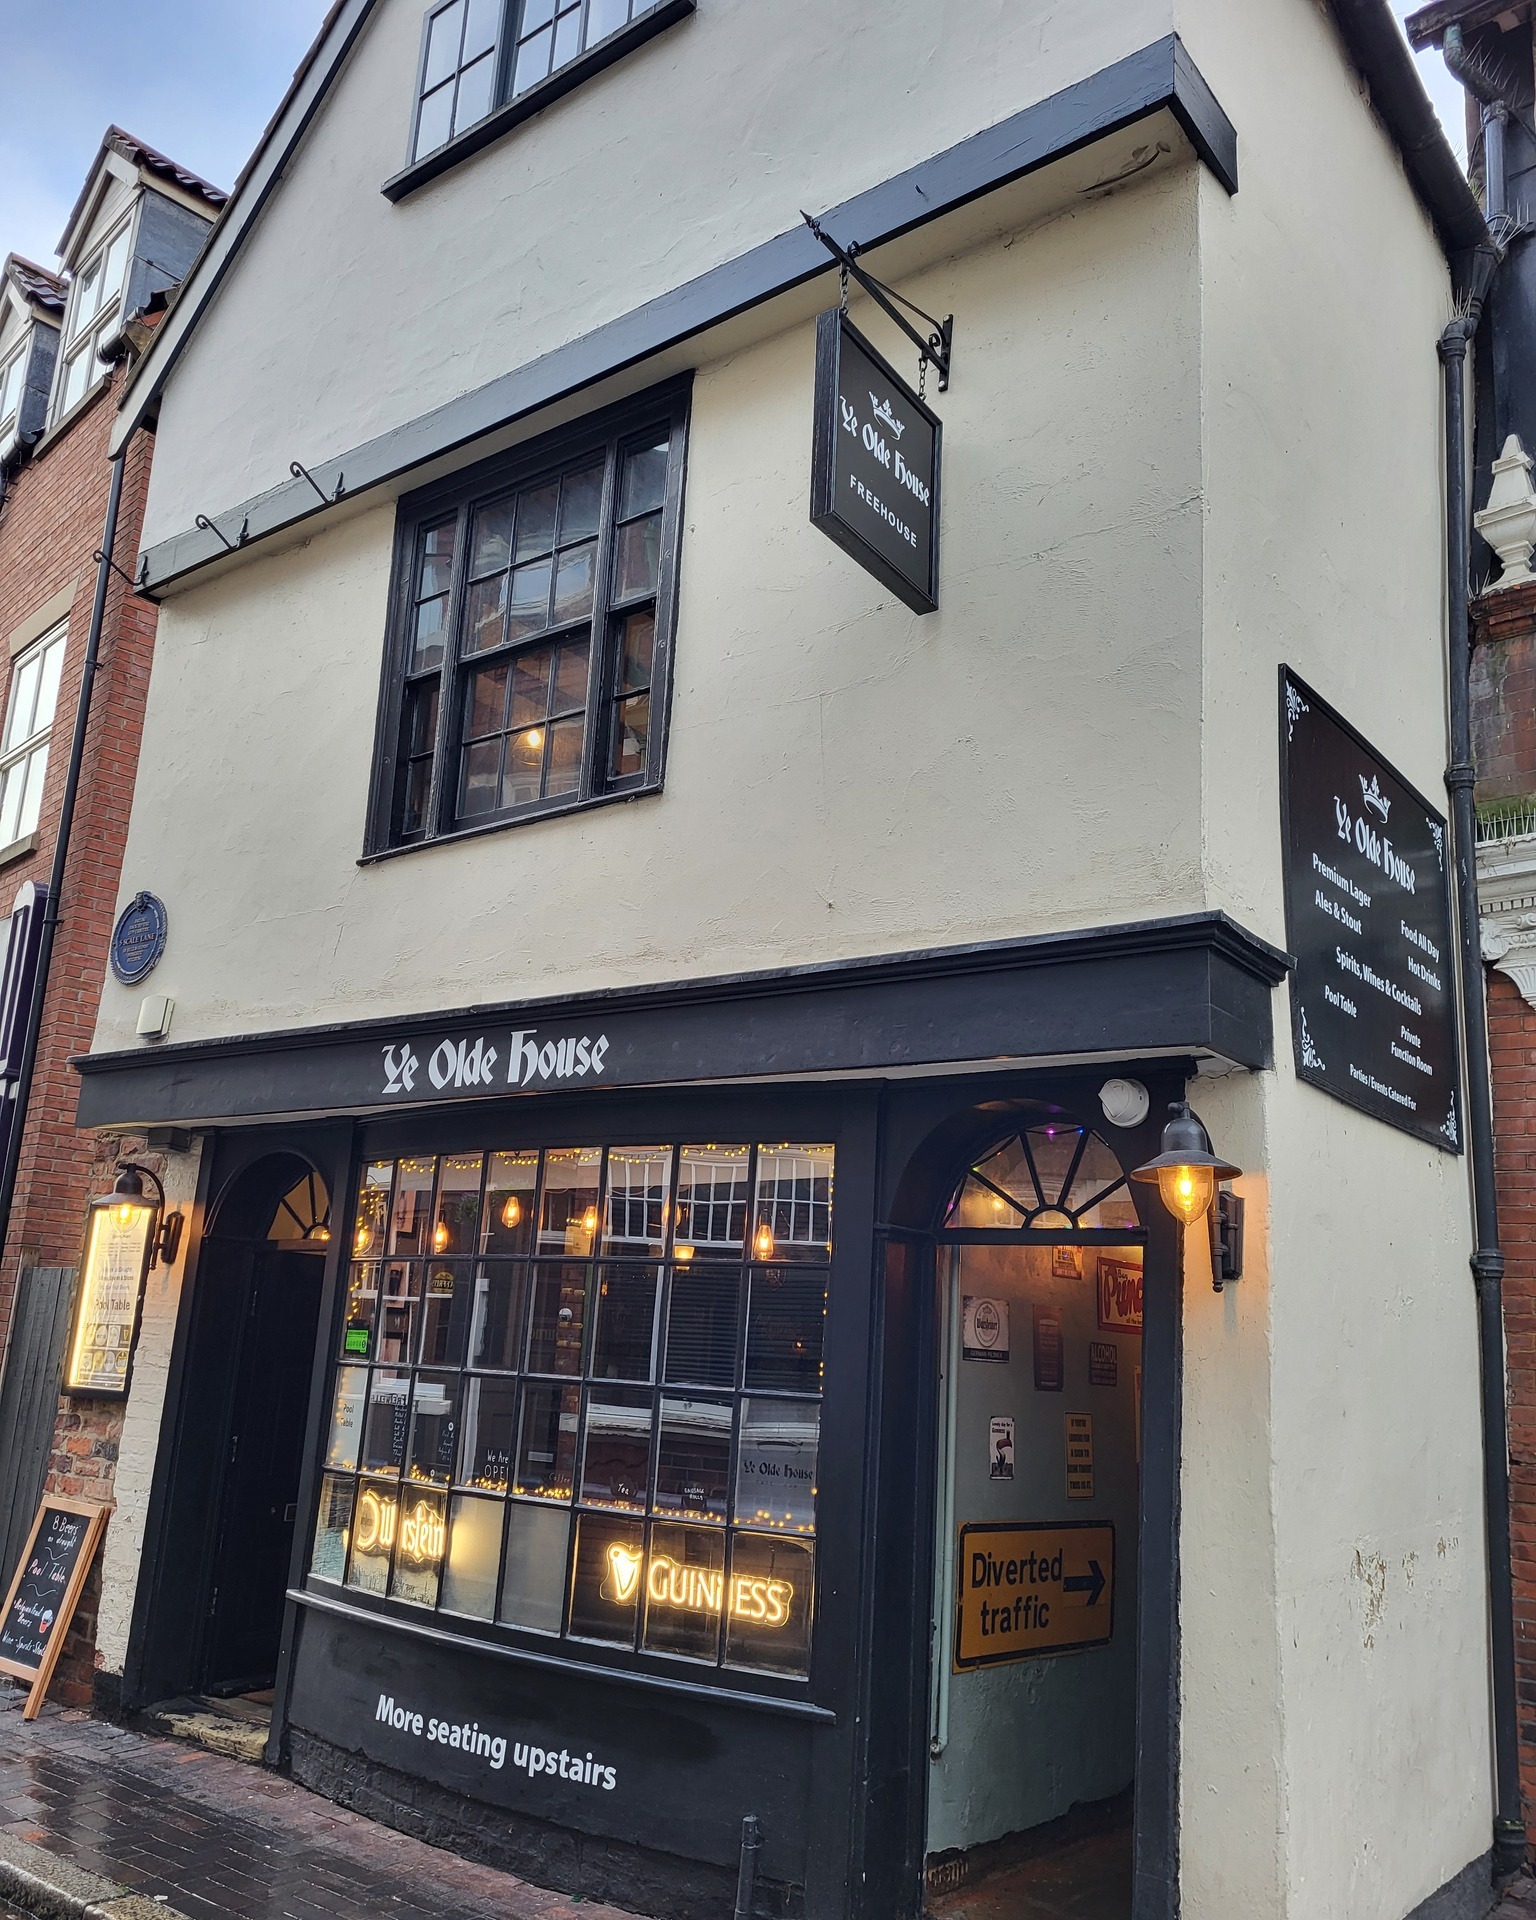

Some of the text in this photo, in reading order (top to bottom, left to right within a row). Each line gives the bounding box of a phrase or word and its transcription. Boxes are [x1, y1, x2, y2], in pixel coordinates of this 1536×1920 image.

[840, 395, 930, 506] Ye Olde House
[850, 474, 917, 548] FREEHOUSE
[1334, 795, 1416, 895] Ye Olde House
[1313, 852, 1371, 908] Premium Lager
[1315, 889, 1362, 935] Ales & Stout
[123, 936, 139, 945] SCALE
[140, 933, 156, 941] LANE
[1401, 919, 1440, 964] Food All Day
[1336, 946, 1422, 1015] Spirits, Wines & Cocktails
[1408, 956, 1441, 991] Hot Drinks
[1325, 985, 1357, 1018] Pool Table
[1401, 1025, 1421, 1048] Private
[381, 1029, 610, 1094] Ye Olde House
[1391, 1042, 1433, 1075] Function Room
[1350, 1064, 1367, 1084] Parties
[1371, 1076, 1387, 1097] Events
[1388, 1086, 1408, 1109] Catered
[1407, 1095, 1417, 1111] For
[111, 1298, 131, 1311] Table
[1091, 1343, 1116, 1363] ALCOHOL
[340, 1417, 354, 1428] Table
[343, 1403, 354, 1414] Pool
[487, 1449, 509, 1464] We Are
[743, 1460, 813, 1479] Ye Olde House
[549, 1472, 571, 1483] Coffee
[618, 1483, 629, 1495] Tea
[52, 1515, 78, 1535] 8 Beers
[56, 1533, 77, 1550] draught
[28, 1559, 66, 1583] Pool Table
[971, 1548, 1063, 1588] Diverted
[980, 1595, 1050, 1636] traffic
[375, 1694, 617, 1790] More seating upstairs
